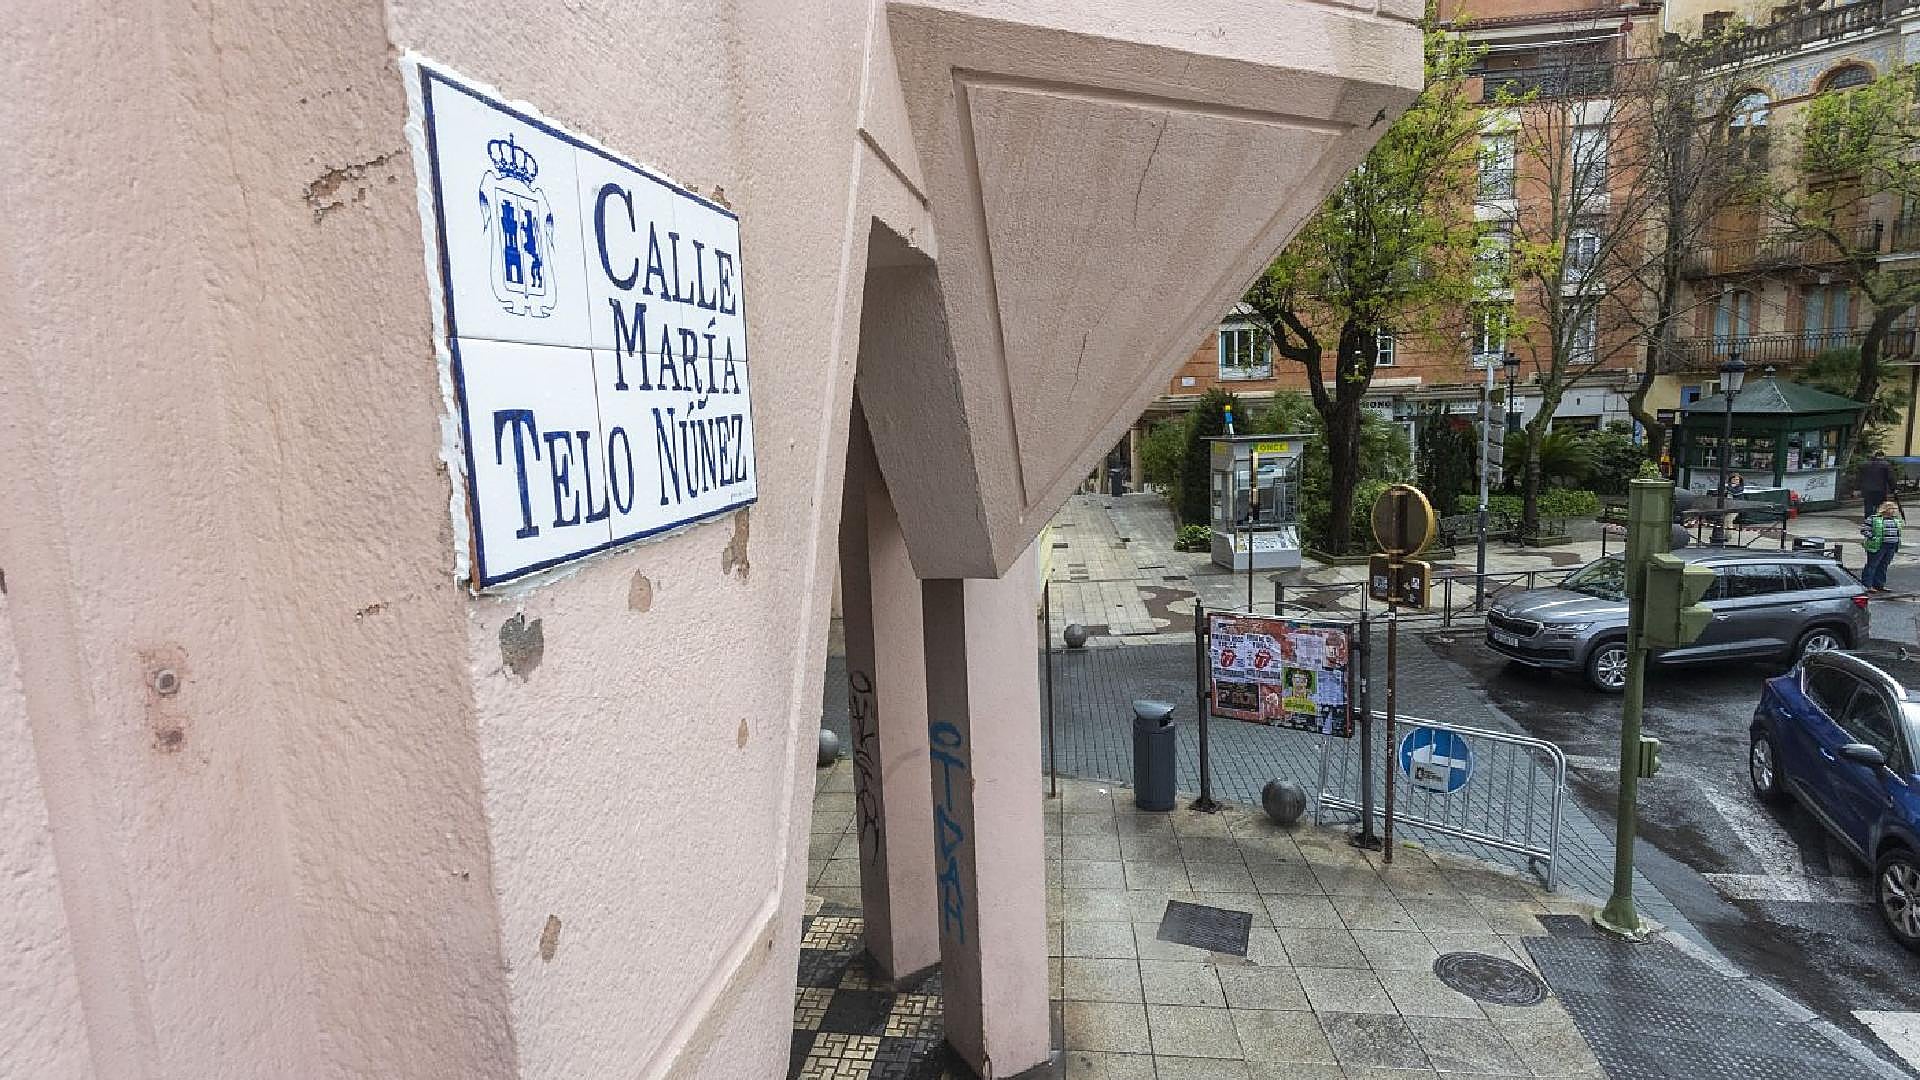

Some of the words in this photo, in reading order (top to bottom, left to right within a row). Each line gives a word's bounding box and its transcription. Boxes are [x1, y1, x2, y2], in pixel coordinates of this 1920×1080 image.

[594, 182, 736, 316] CALLE
[609, 297, 741, 394] MARÍA
[493, 409, 636, 539] TELO
[652, 394, 748, 506] NÚÑEZ
